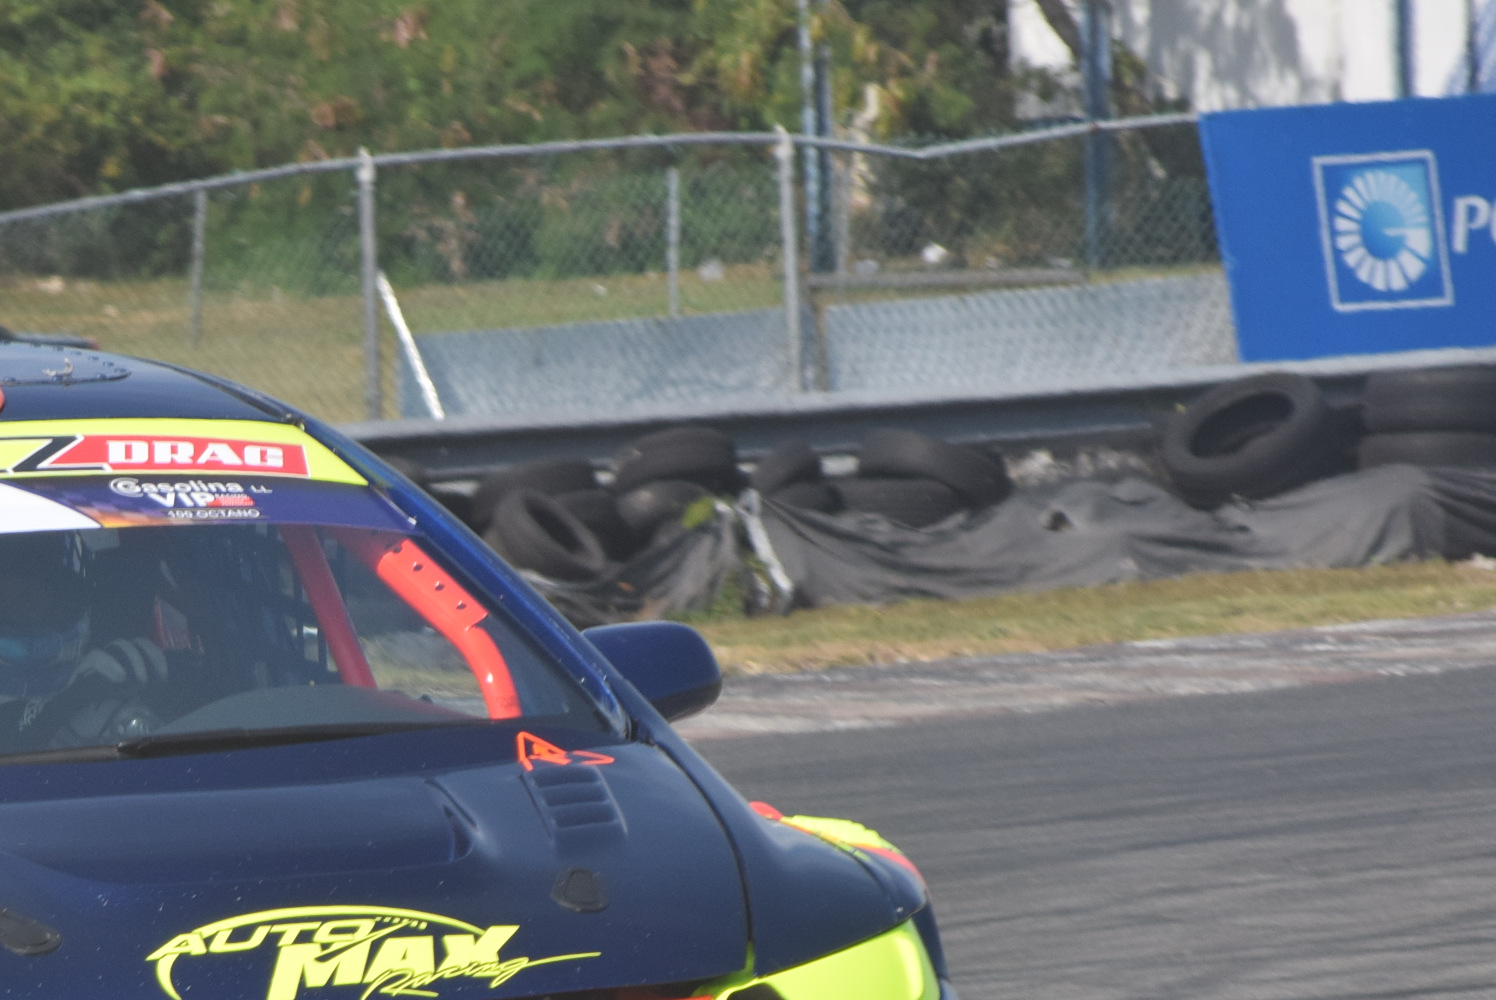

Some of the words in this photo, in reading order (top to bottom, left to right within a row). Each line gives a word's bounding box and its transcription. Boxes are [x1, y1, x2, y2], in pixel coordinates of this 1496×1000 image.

[1452, 195, 1496, 254] P
[108, 440, 283, 468] DRAG
[109, 477, 244, 498] Gasolina
[147, 491, 215, 508] VIP
[145, 918, 377, 962] AUTO
